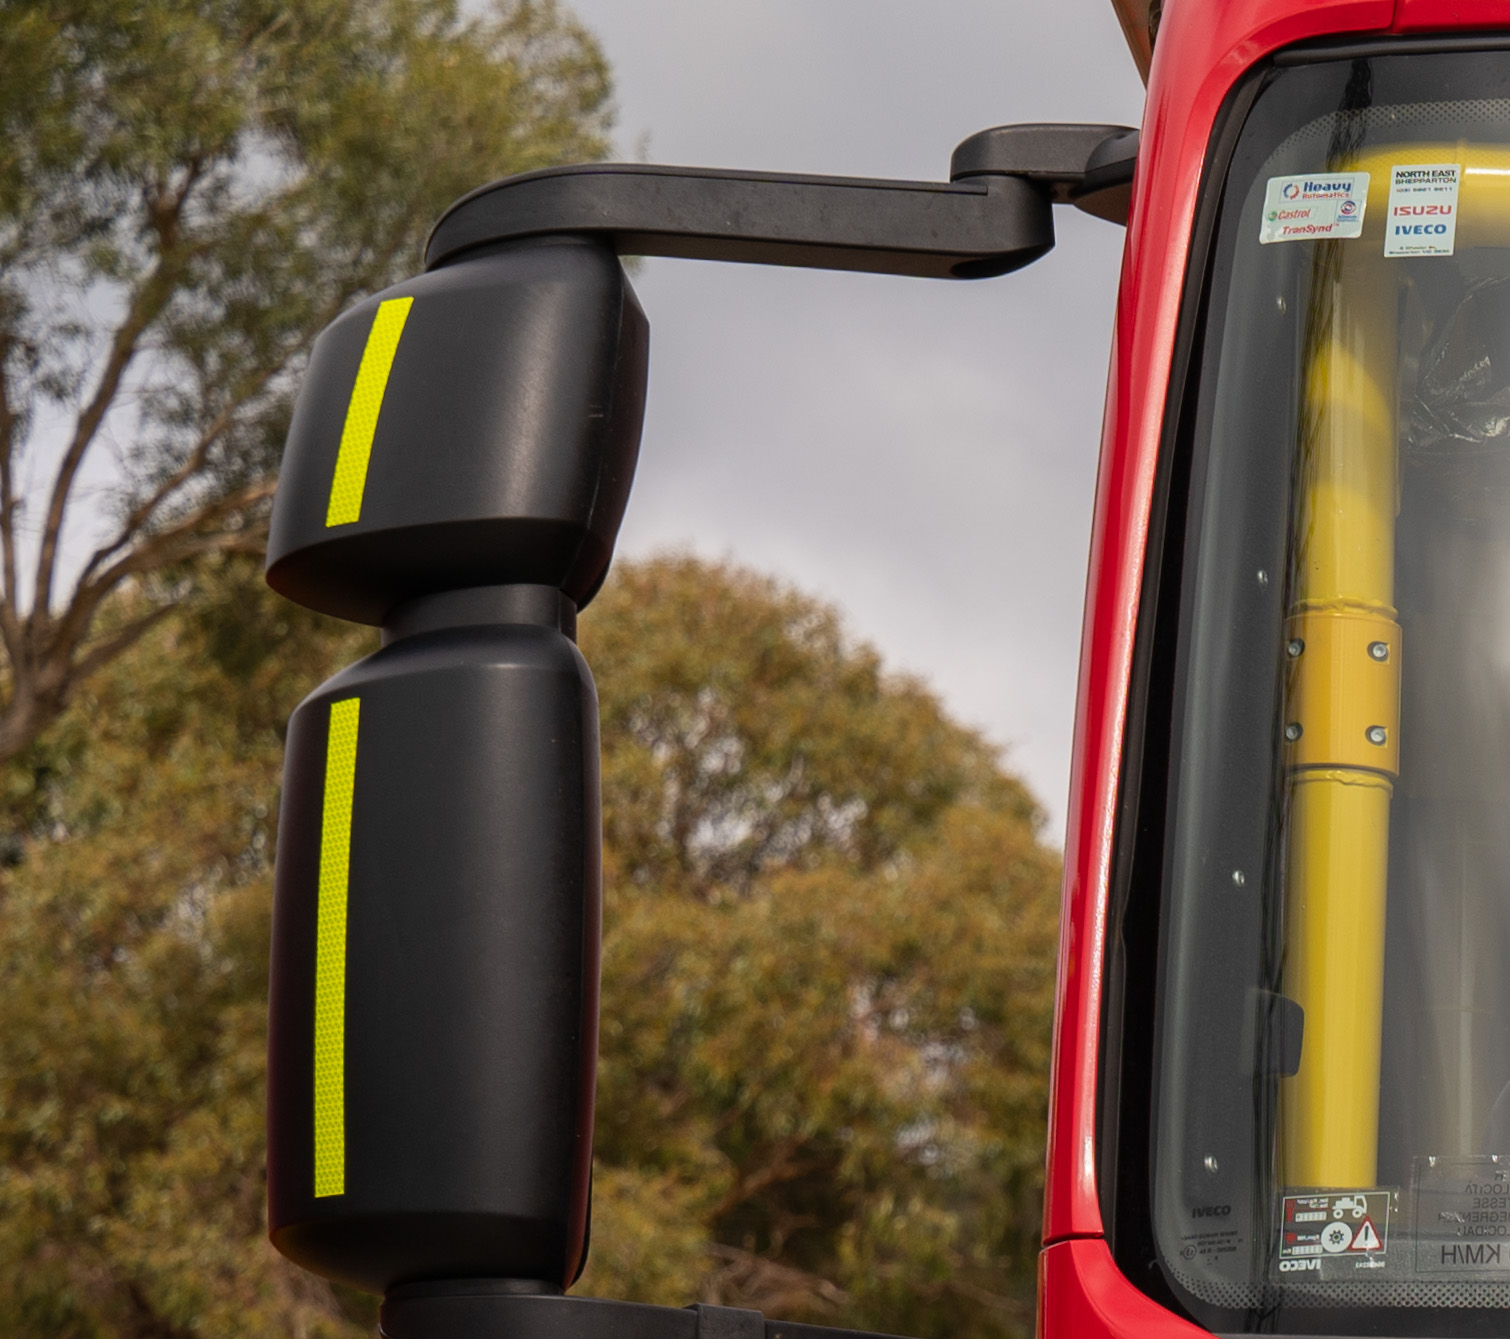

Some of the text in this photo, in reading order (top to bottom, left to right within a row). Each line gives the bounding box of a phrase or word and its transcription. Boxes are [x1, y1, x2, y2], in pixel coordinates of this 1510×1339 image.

[1396, 169, 1456, 178] NORTH EAST
[1303, 181, 1352, 192] Heavy
[1395, 177, 1456, 185] SHEPPARTON
[1277, 208, 1312, 220] Castrol
[1394, 205, 1452, 216] ISUZU
[1395, 224, 1447, 235] IVECO
[1192, 1205, 1232, 1218] IVECO
